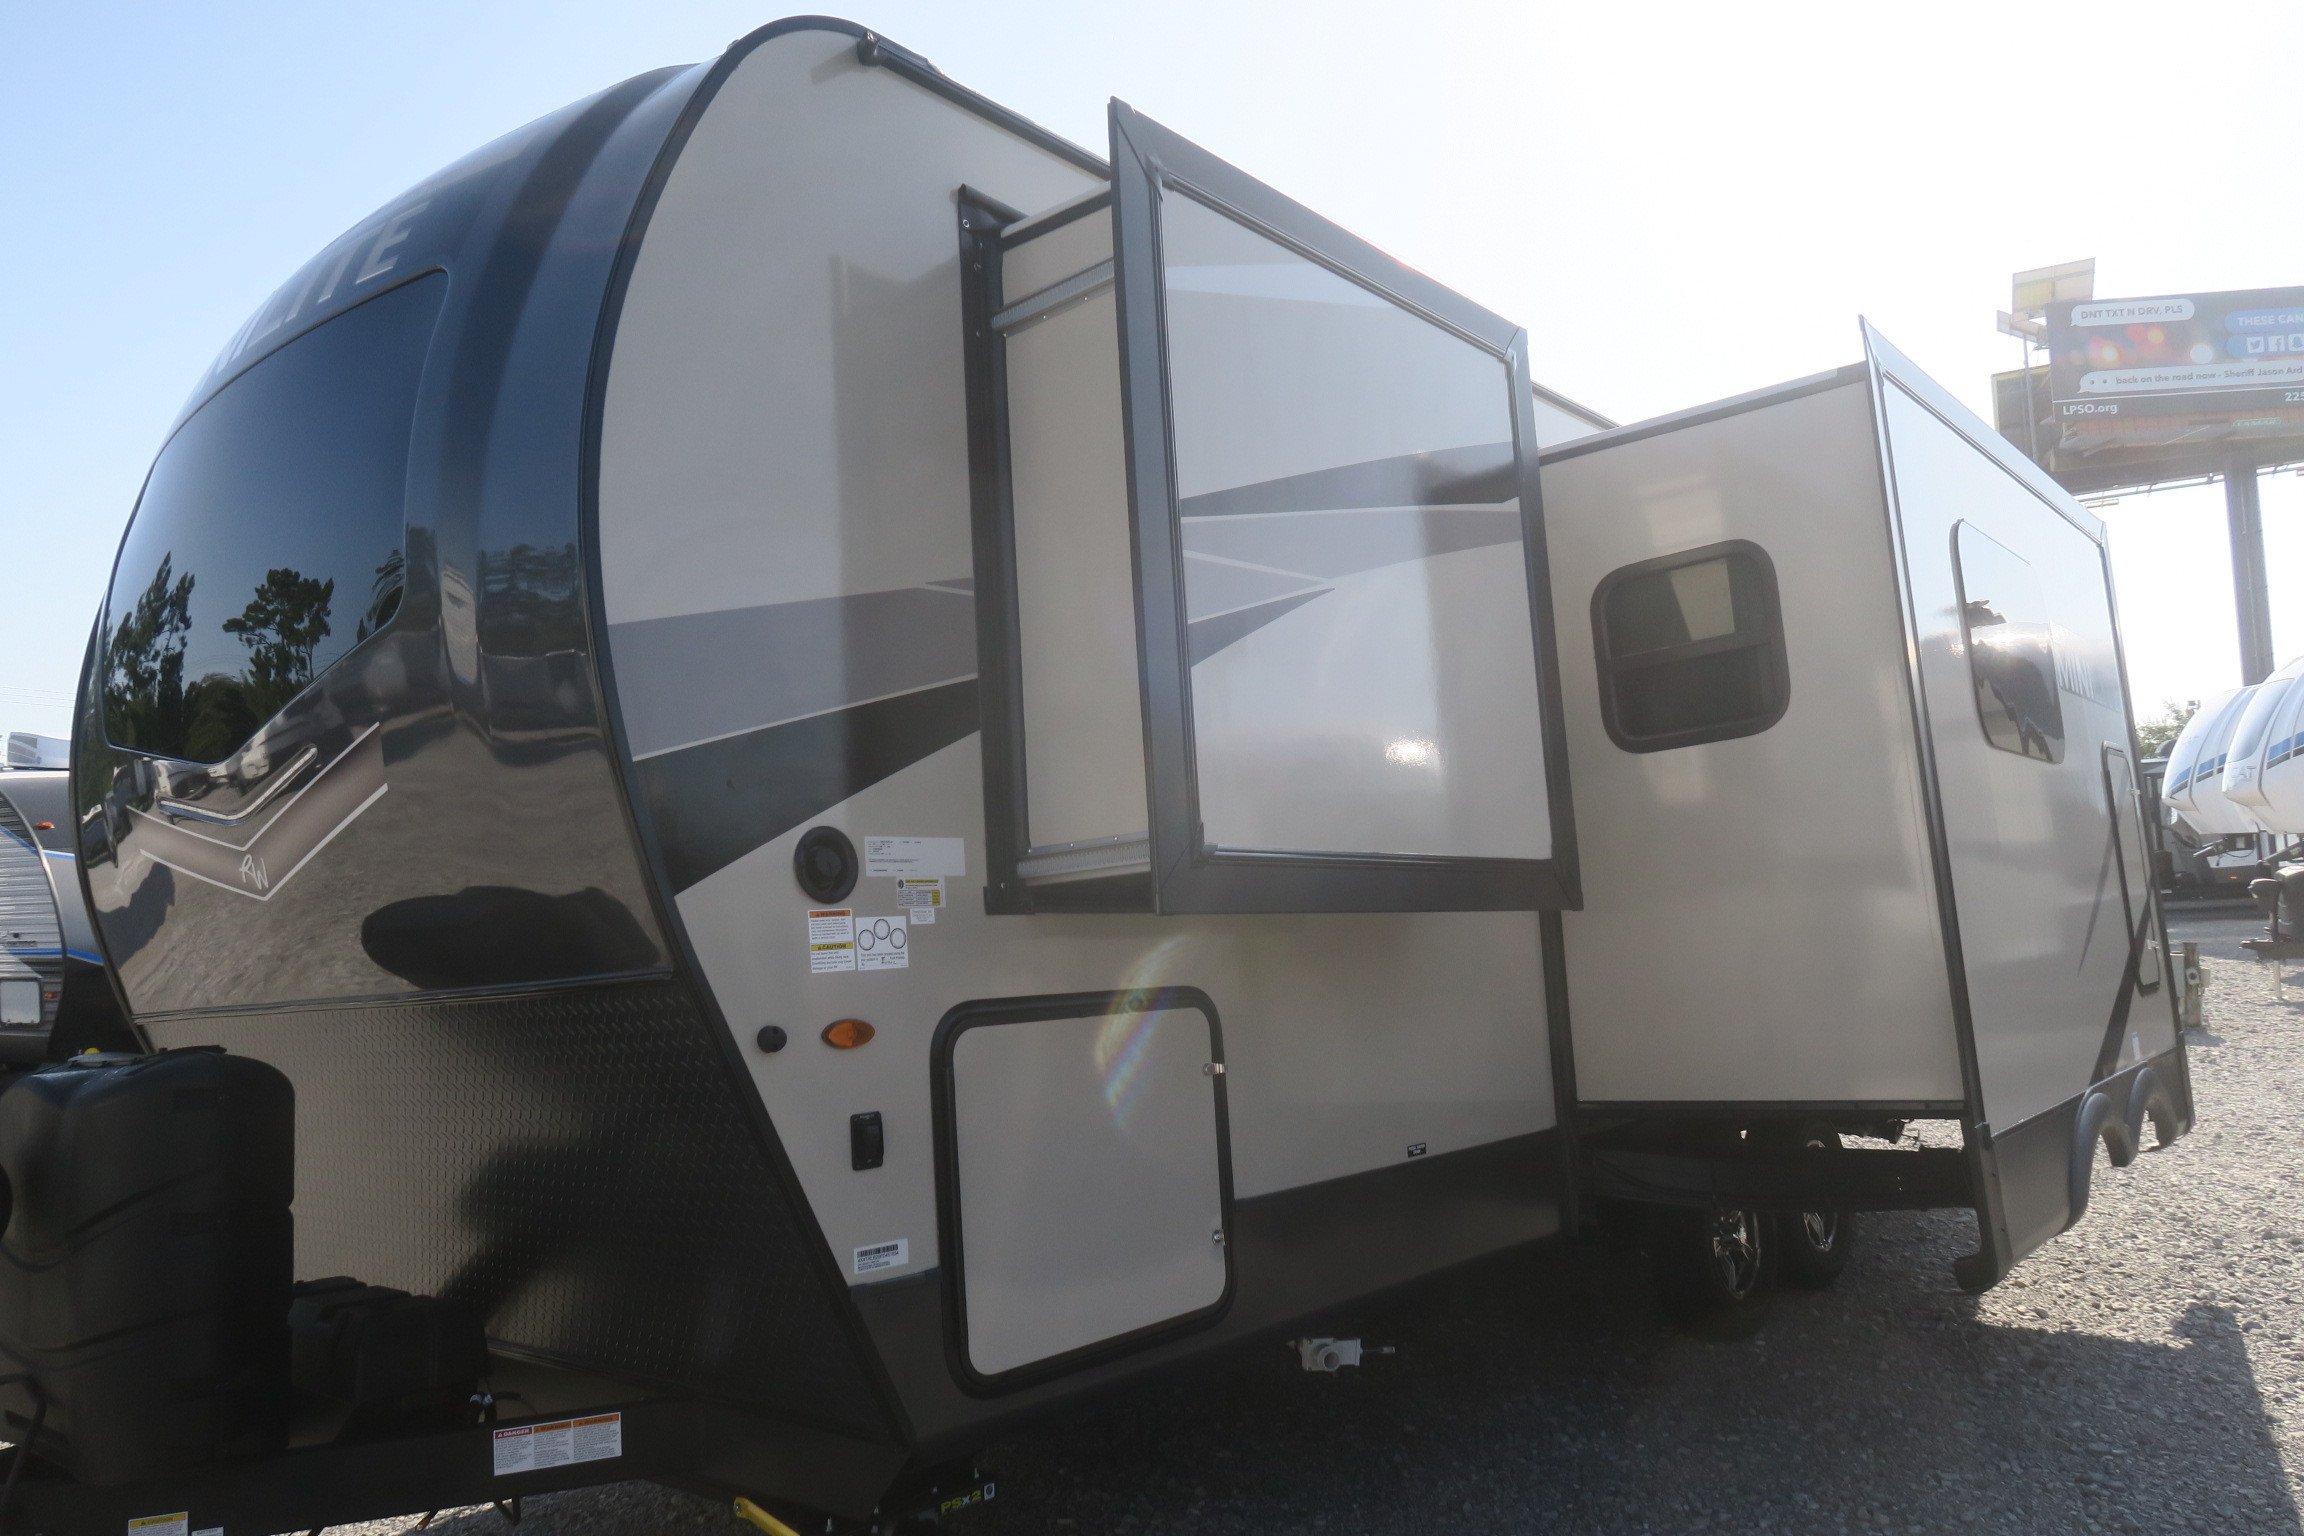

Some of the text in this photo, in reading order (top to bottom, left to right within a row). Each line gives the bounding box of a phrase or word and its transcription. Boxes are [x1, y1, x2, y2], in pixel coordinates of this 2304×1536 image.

[2081, 304, 2183, 319] DNT TXT N DRV, PLS
[2237, 315, 2275, 326] THESE
[2115, 376, 2138, 384] back
[2154, 374, 2169, 382] the
[2172, 372, 2193, 382] road
[2224, 368, 2255, 378] Sheriff
[2257, 367, 2285, 376] Jason
[2063, 403, 2118, 416] LPSO.org
[503, 1428, 530, 1437] DANGER
